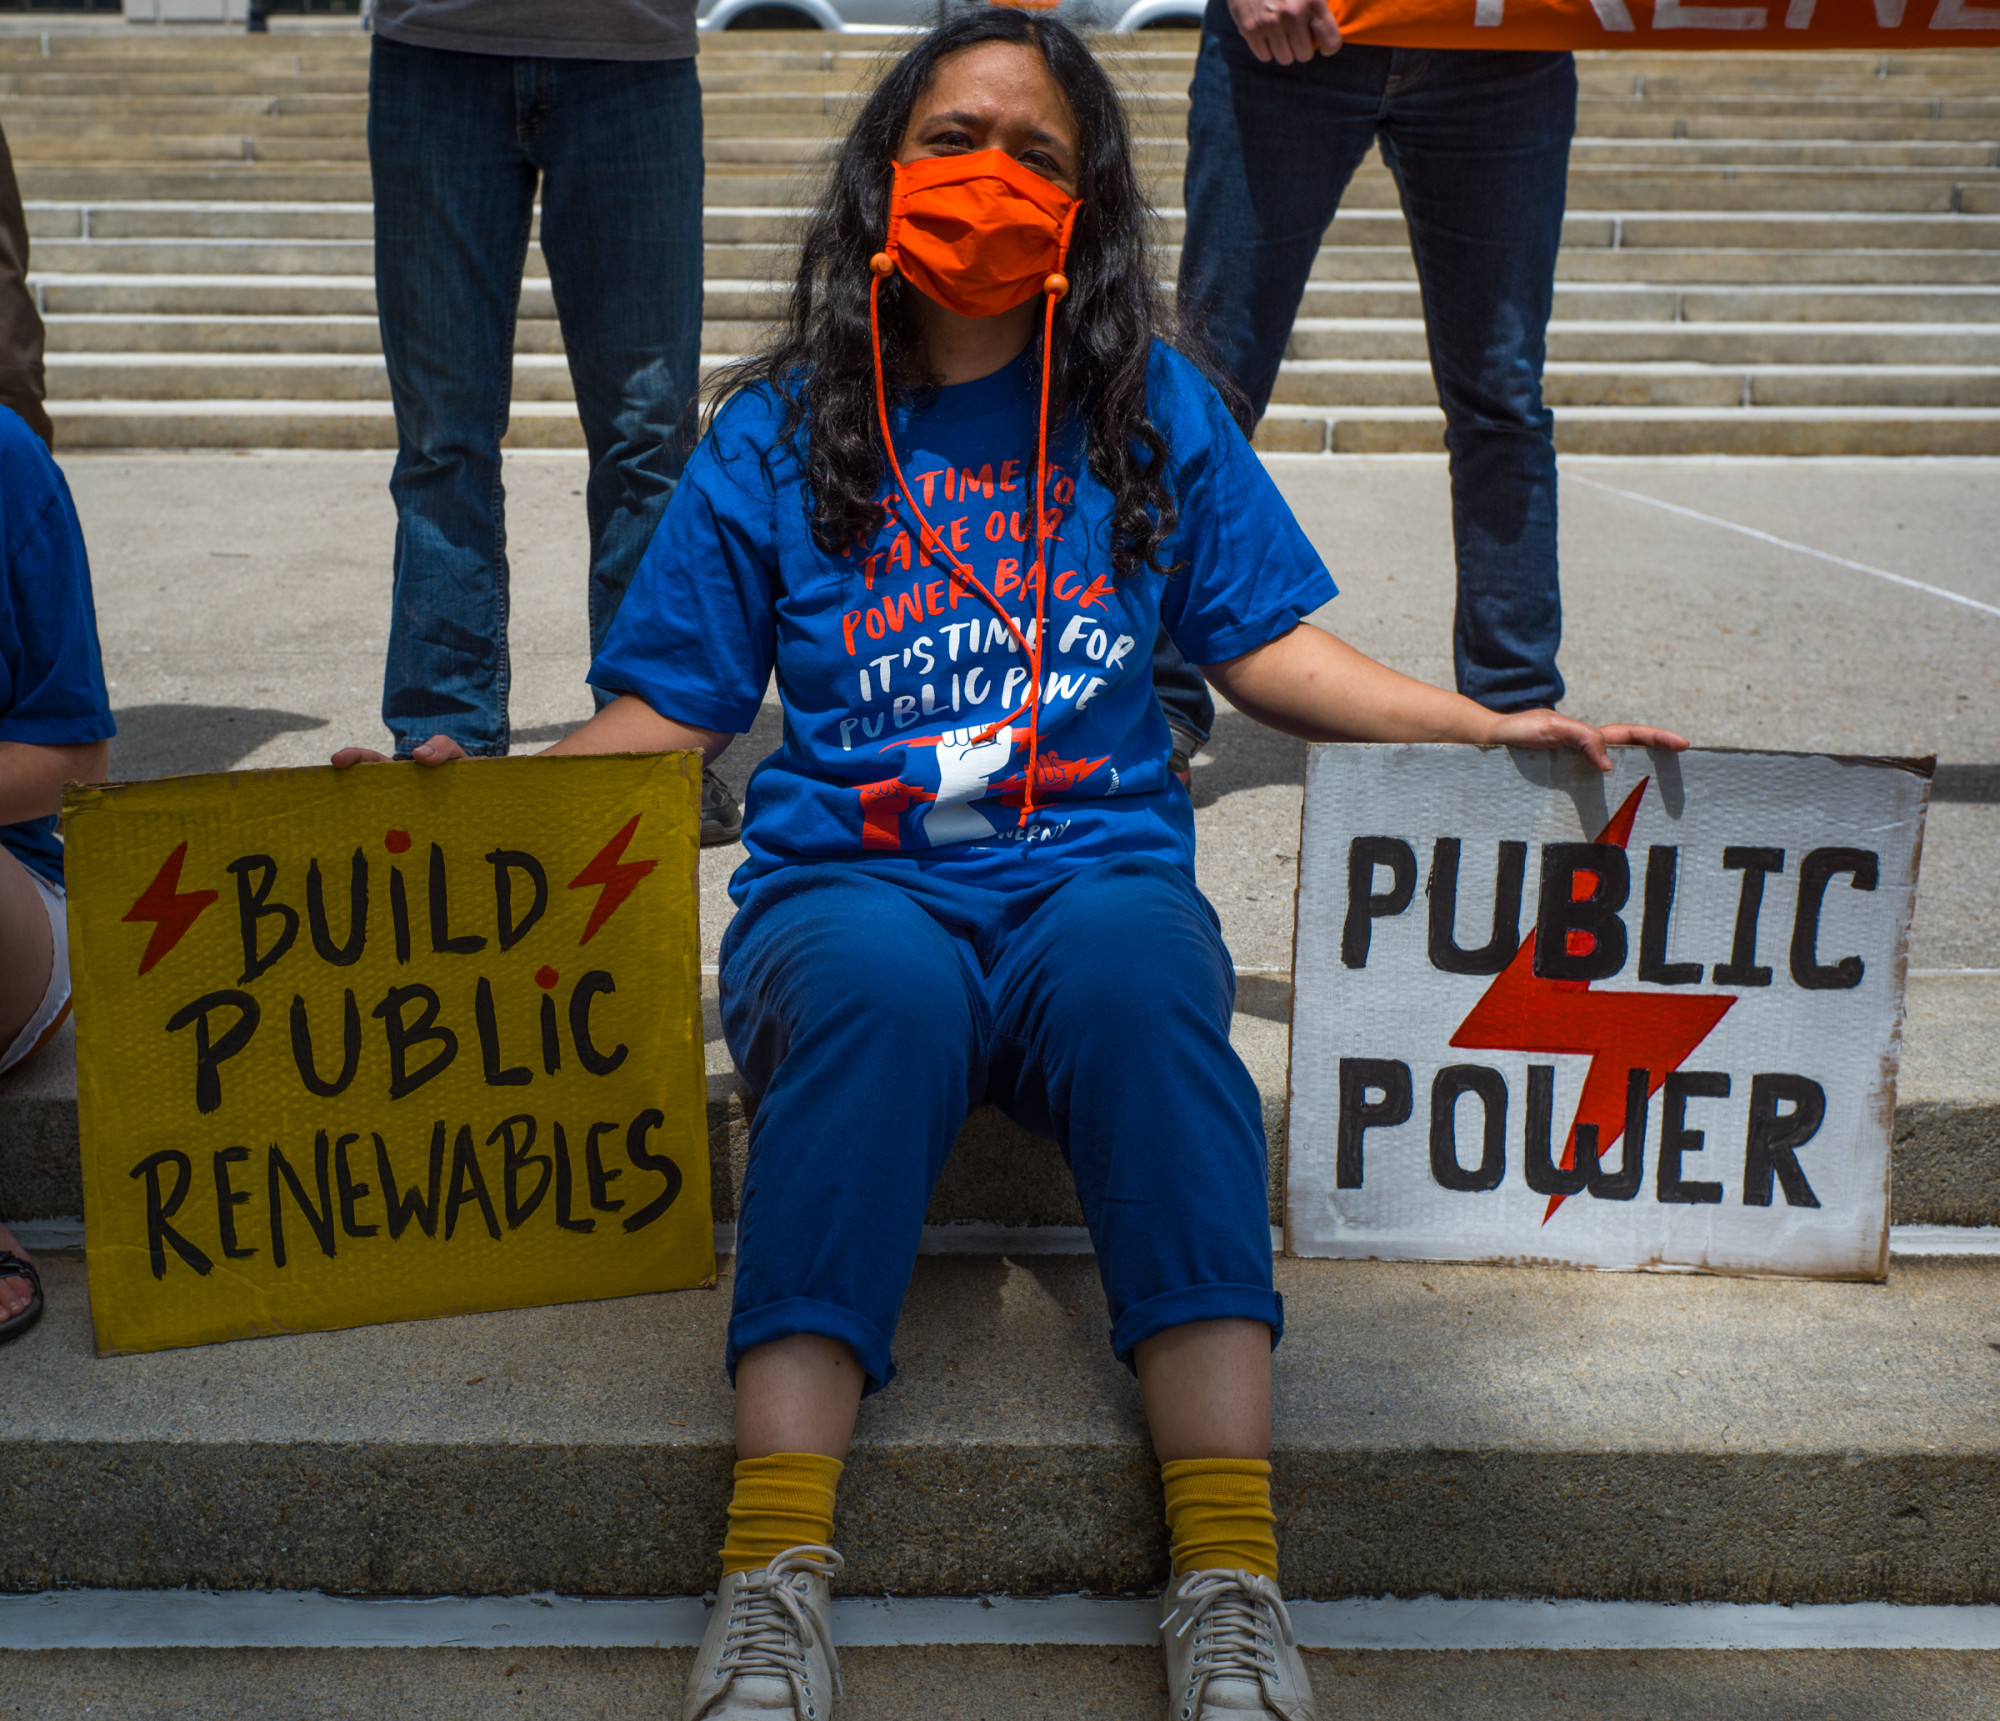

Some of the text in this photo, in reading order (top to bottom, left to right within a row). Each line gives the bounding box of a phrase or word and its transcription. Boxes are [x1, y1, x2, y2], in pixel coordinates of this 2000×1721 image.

[914, 460, 1075, 508] TIME TO
[858, 516, 970, 590] TAKE
[984, 507, 1065, 542] OUR
[842, 558, 1118, 656] POWER BACK
[859, 615, 1135, 701] IT'S TIME FOR
[839, 667, 991, 751] PUBLIC
[1341, 836, 1880, 990] PUBLIC
[1336, 1057, 1828, 1209] POWER
[130, 1107, 684, 1281] RENEWABLES
